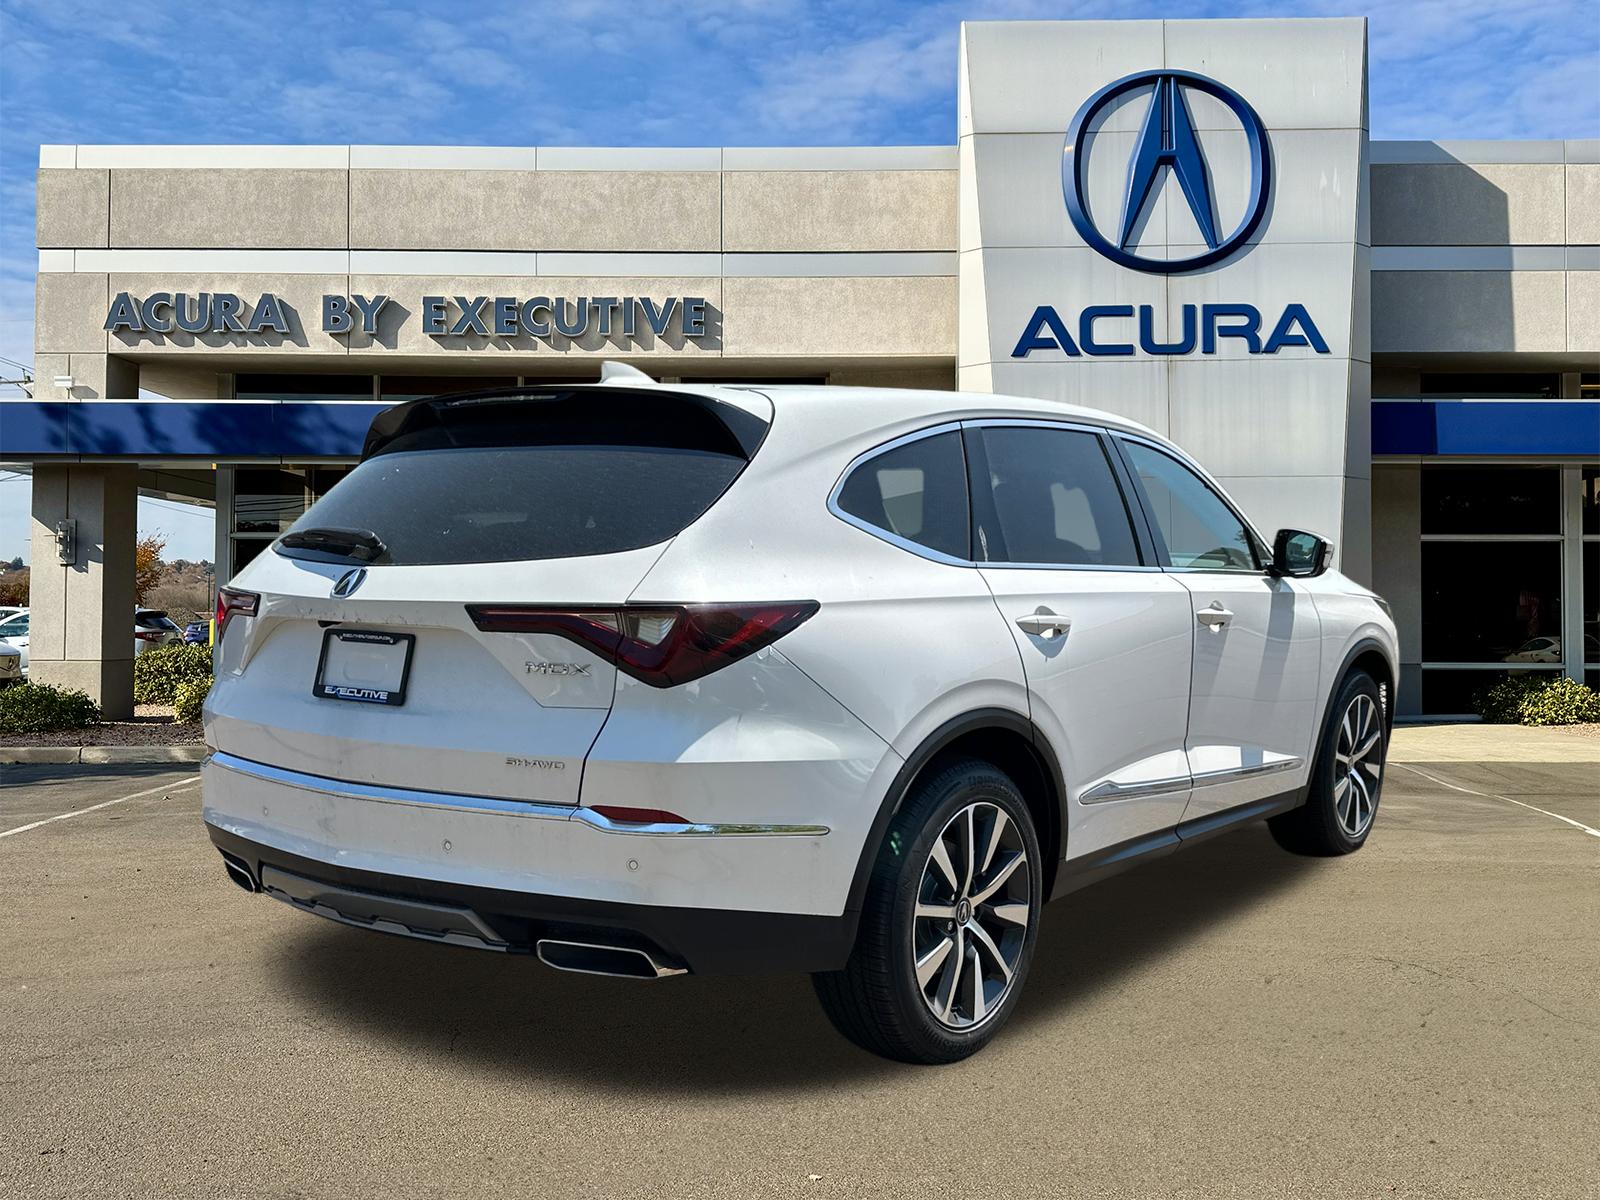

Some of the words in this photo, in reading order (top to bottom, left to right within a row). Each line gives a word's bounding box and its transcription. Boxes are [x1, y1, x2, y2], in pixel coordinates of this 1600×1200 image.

[104, 292, 290, 335] ACURA
[322, 294, 390, 335] BY
[422, 296, 707, 338] EXECUTIVE
[1011, 303, 1331, 357] ACURA
[525, 661, 592, 677] MDX
[324, 686, 389, 700] EXECUTIVE
